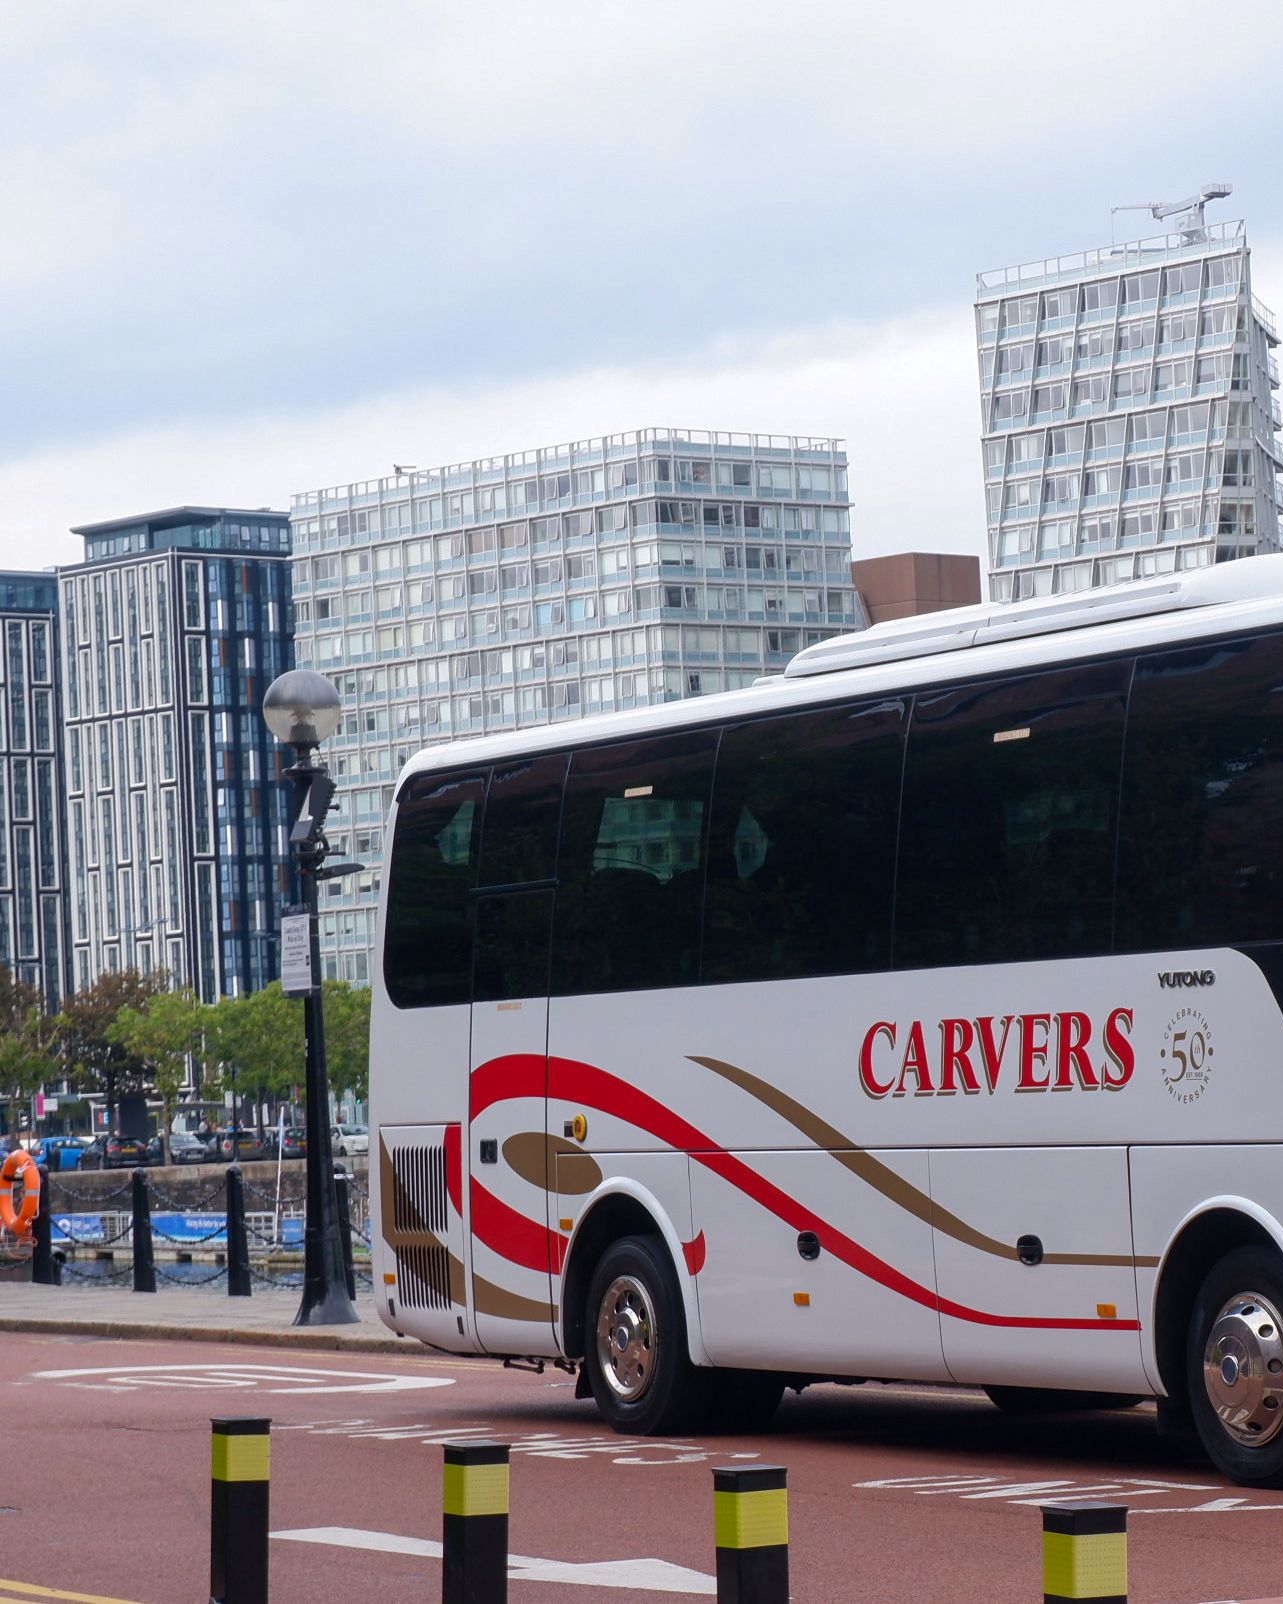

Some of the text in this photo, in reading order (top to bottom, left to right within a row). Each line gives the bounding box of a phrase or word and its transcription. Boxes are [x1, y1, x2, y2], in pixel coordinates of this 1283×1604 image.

[1158, 970, 1216, 989] YUTONG
[1163, 1007, 1212, 1040] CELEBRATING
[858, 1007, 1135, 1100] CARVERS
[1161, 1066, 1213, 1104] ANNIVERSARY
